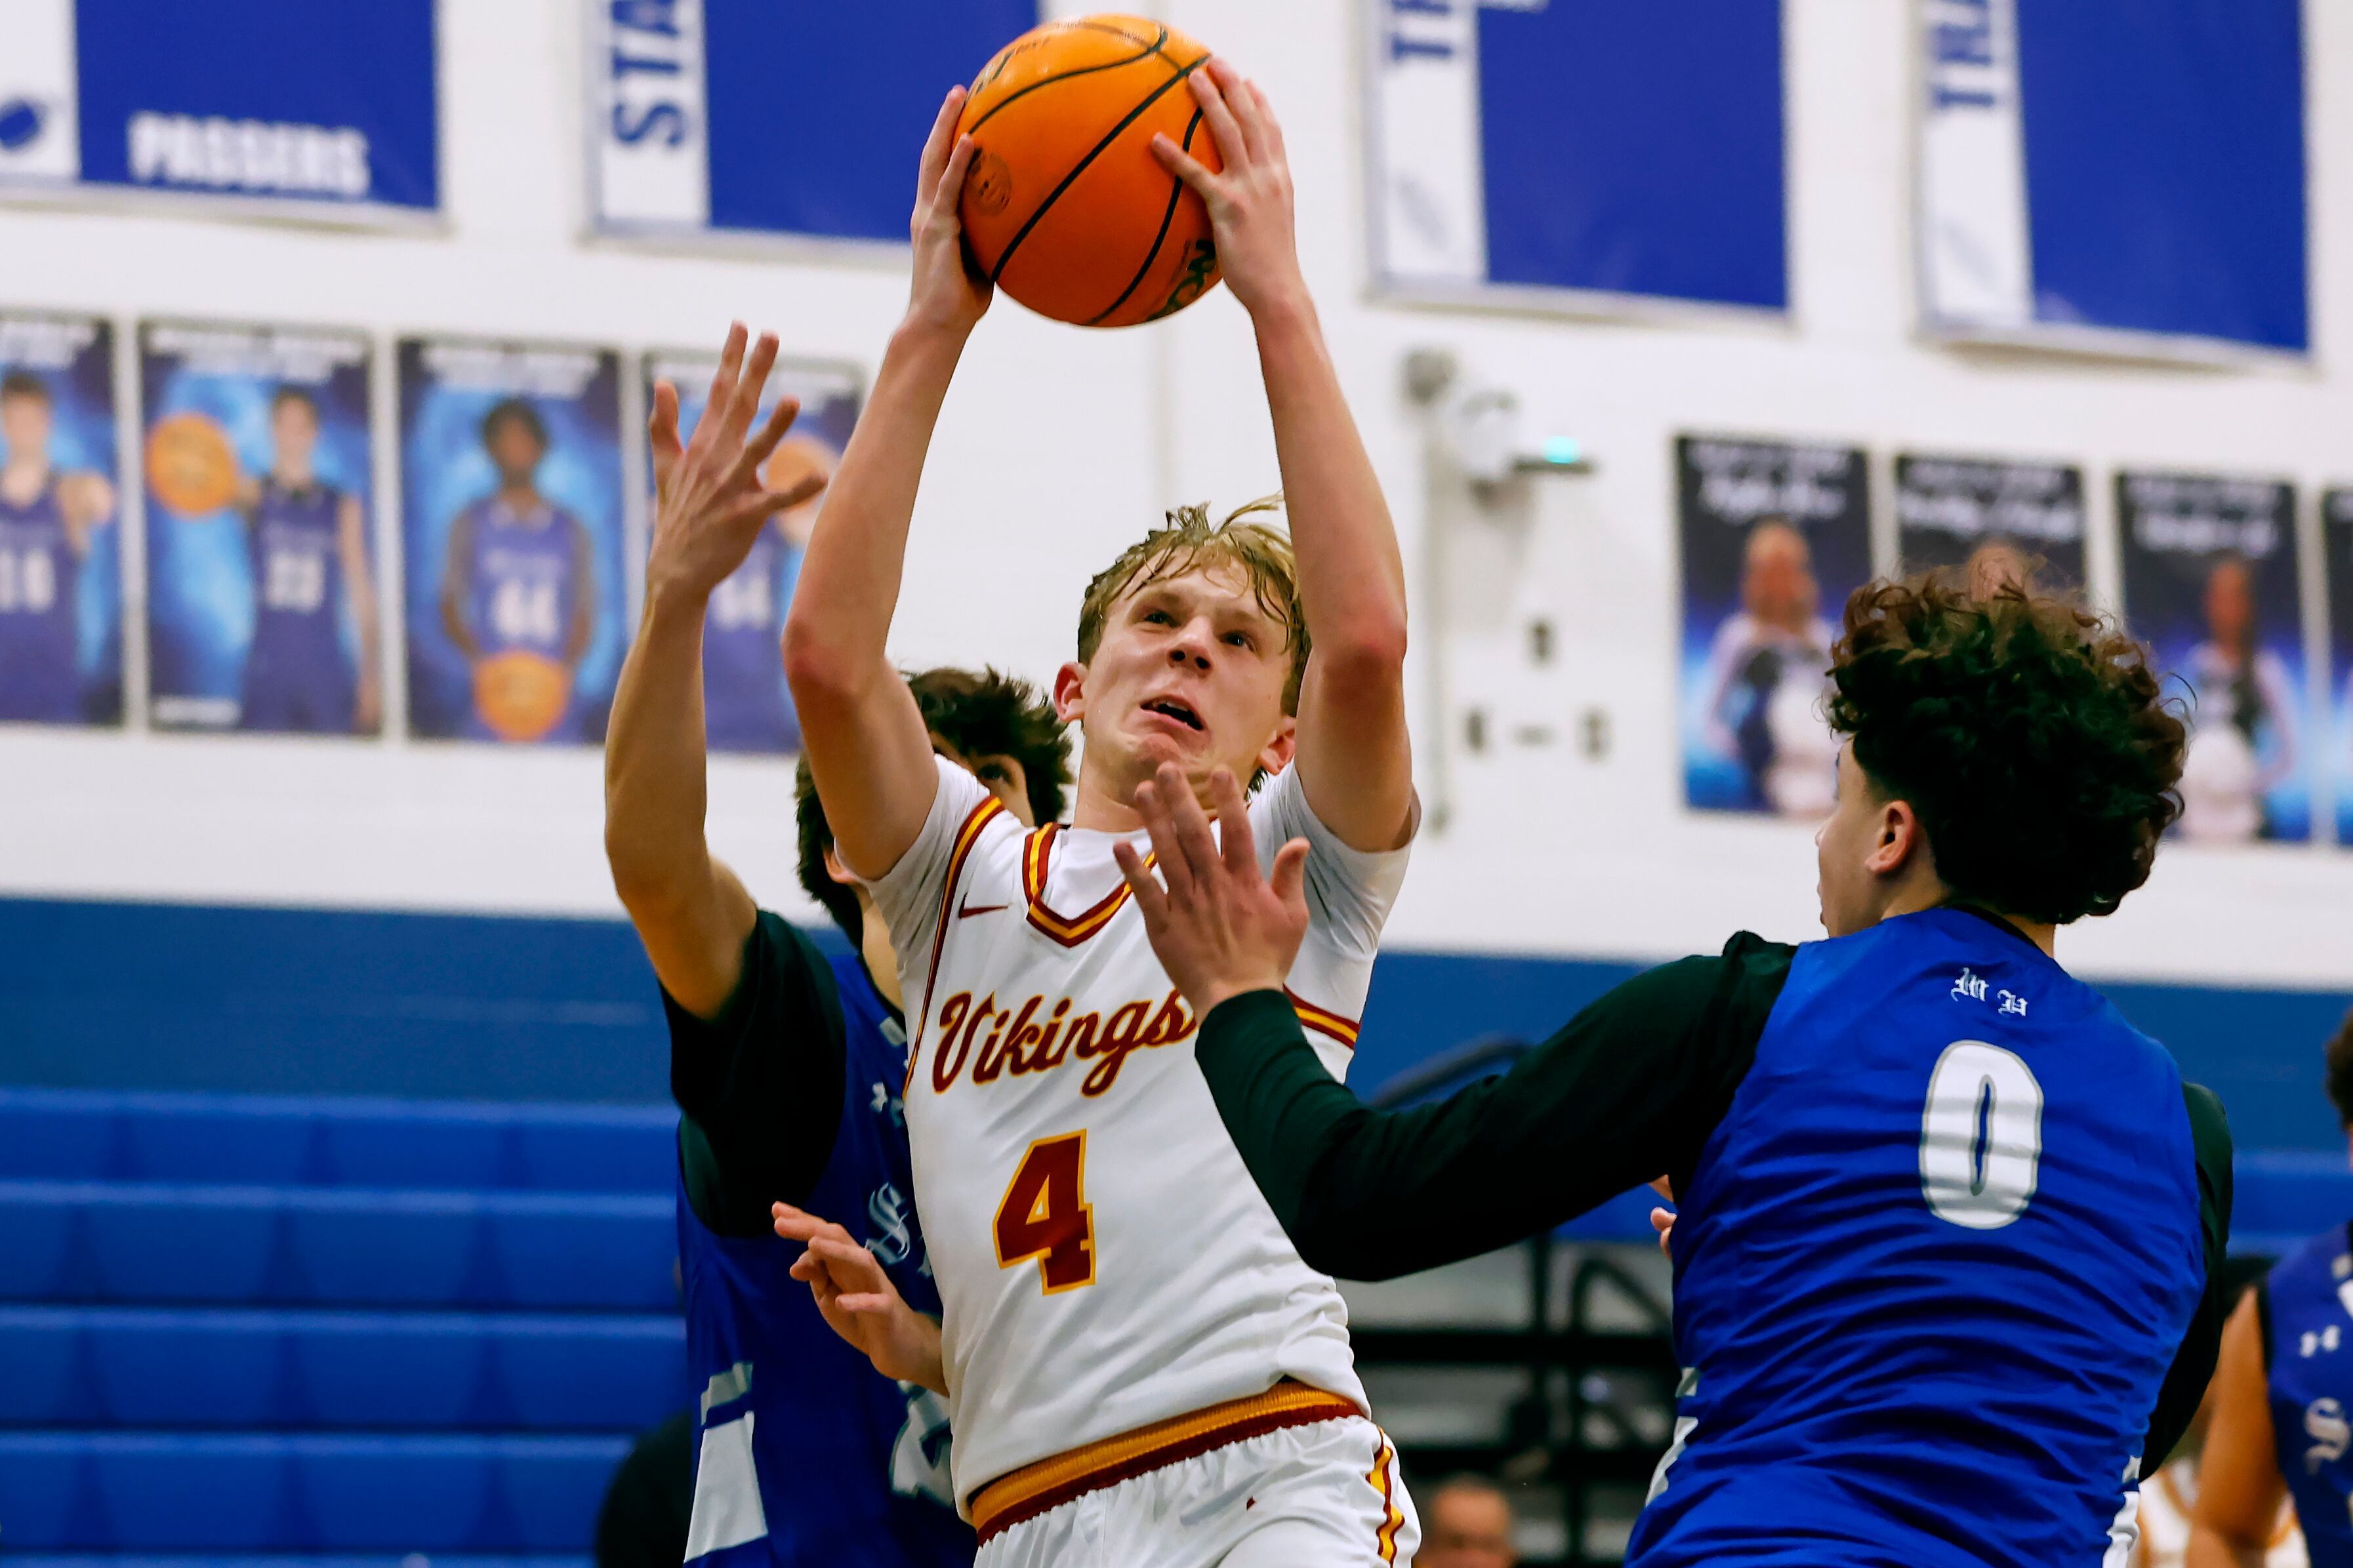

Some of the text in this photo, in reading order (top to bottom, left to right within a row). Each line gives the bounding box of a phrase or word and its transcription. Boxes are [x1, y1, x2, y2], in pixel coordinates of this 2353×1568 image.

[1931, 0, 1995, 114] TR
[932, 988, 1199, 1098] Vikings
[1919, 1039, 2044, 1230] 0
[992, 1128, 1096, 1297] 4
